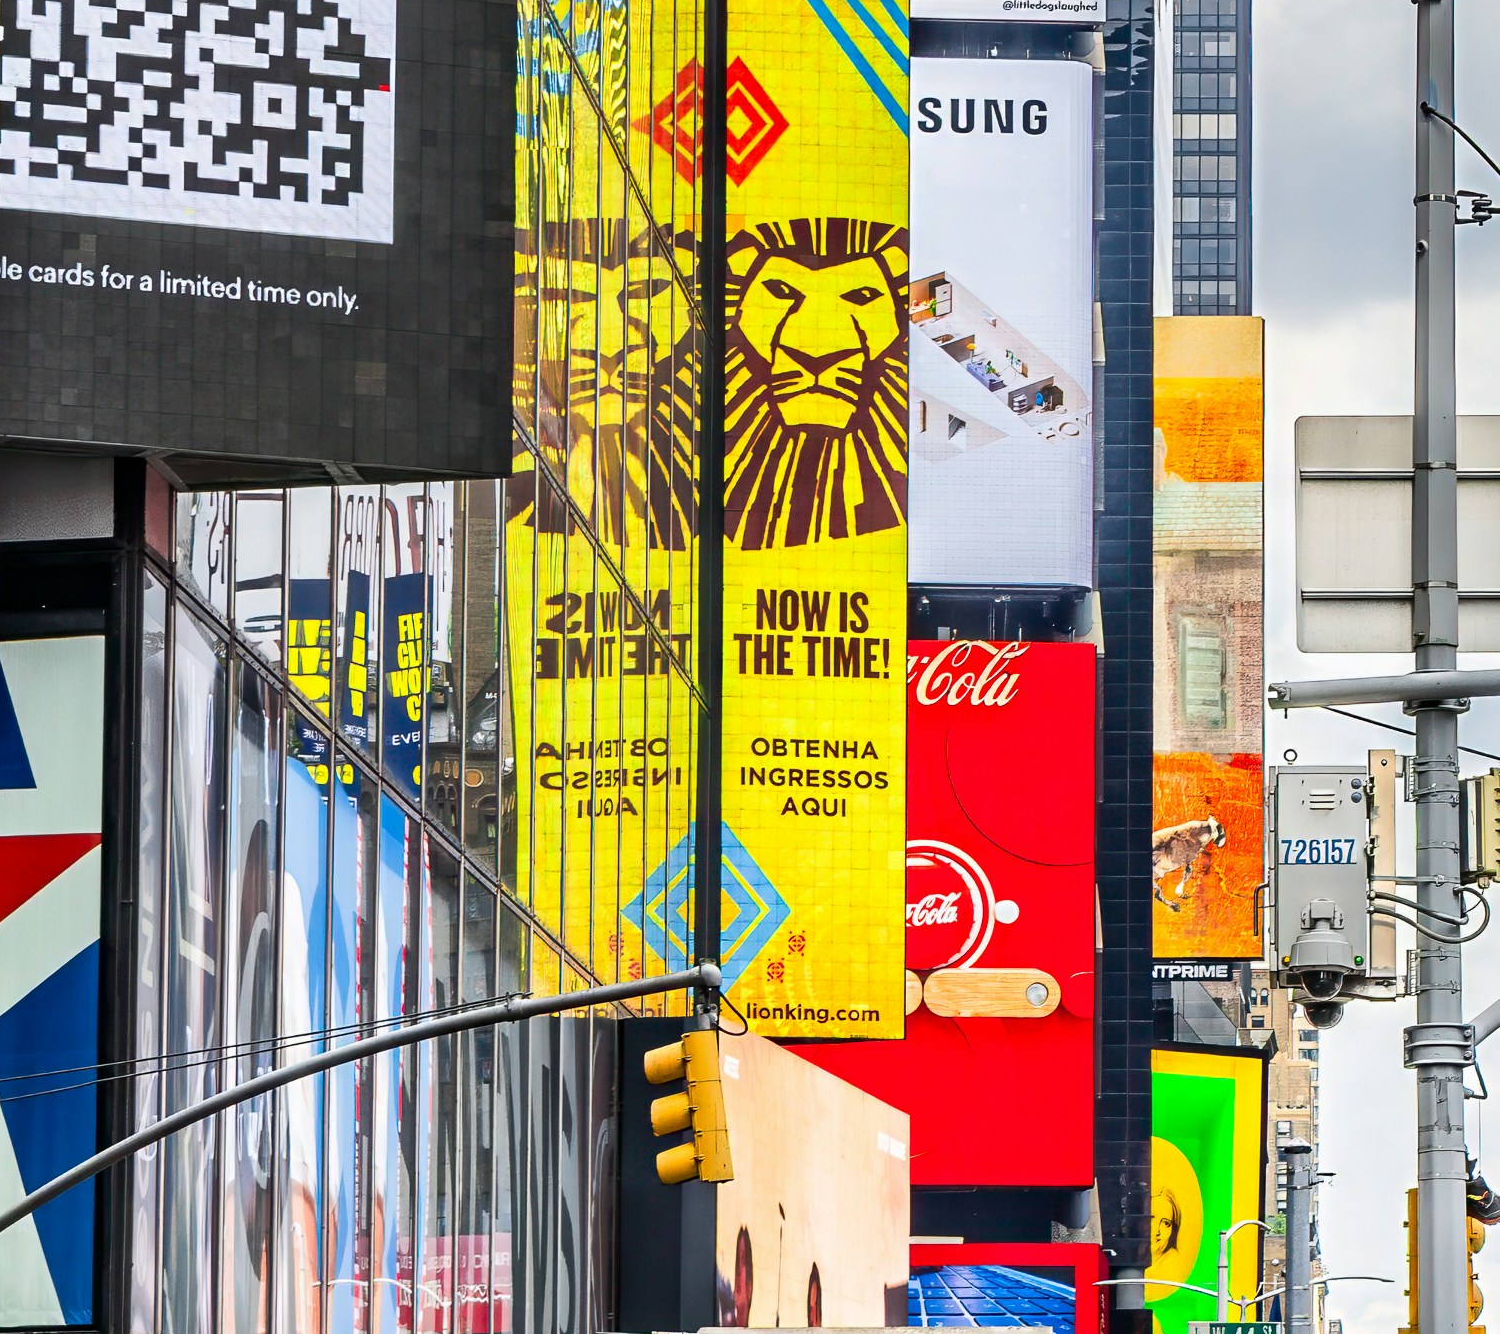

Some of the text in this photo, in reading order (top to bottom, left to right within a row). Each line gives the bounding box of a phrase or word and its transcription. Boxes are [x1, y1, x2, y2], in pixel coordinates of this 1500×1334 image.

[29, 264, 94, 287] cards
[101, 266, 133, 290] for
[139, 274, 153, 292] a
[160, 271, 241, 299] limited
[248, 280, 301, 305] time
[307, 287, 359, 314] only.
[756, 589, 869, 632] NOW IS
[734, 634, 890, 679] THE TIME!
[751, 737, 878, 760] OBTENHA
[740, 767, 889, 789] INGRESSOS
[781, 797, 846, 817] AQUI
[747, 1002, 880, 1023] lionking.com
